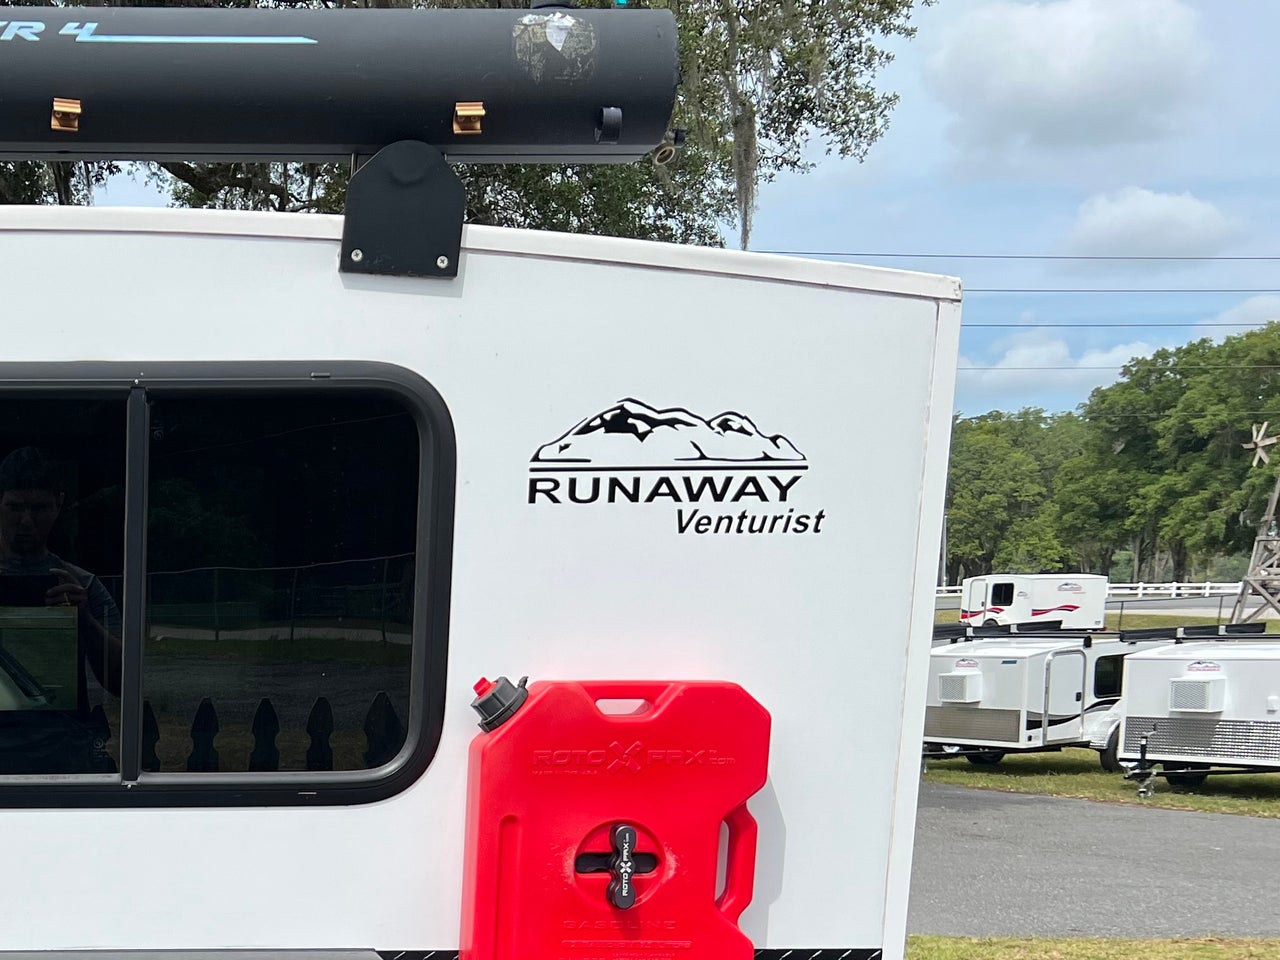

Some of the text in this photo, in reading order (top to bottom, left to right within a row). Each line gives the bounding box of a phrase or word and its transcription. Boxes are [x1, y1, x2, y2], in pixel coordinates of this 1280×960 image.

[58, 22, 99, 43] 4
[528, 475, 803, 505] RUNAWAY
[675, 508, 826, 535] Venturist
[532, 749, 606, 766] ROTO
[562, 920, 677, 930] GASOLINE
